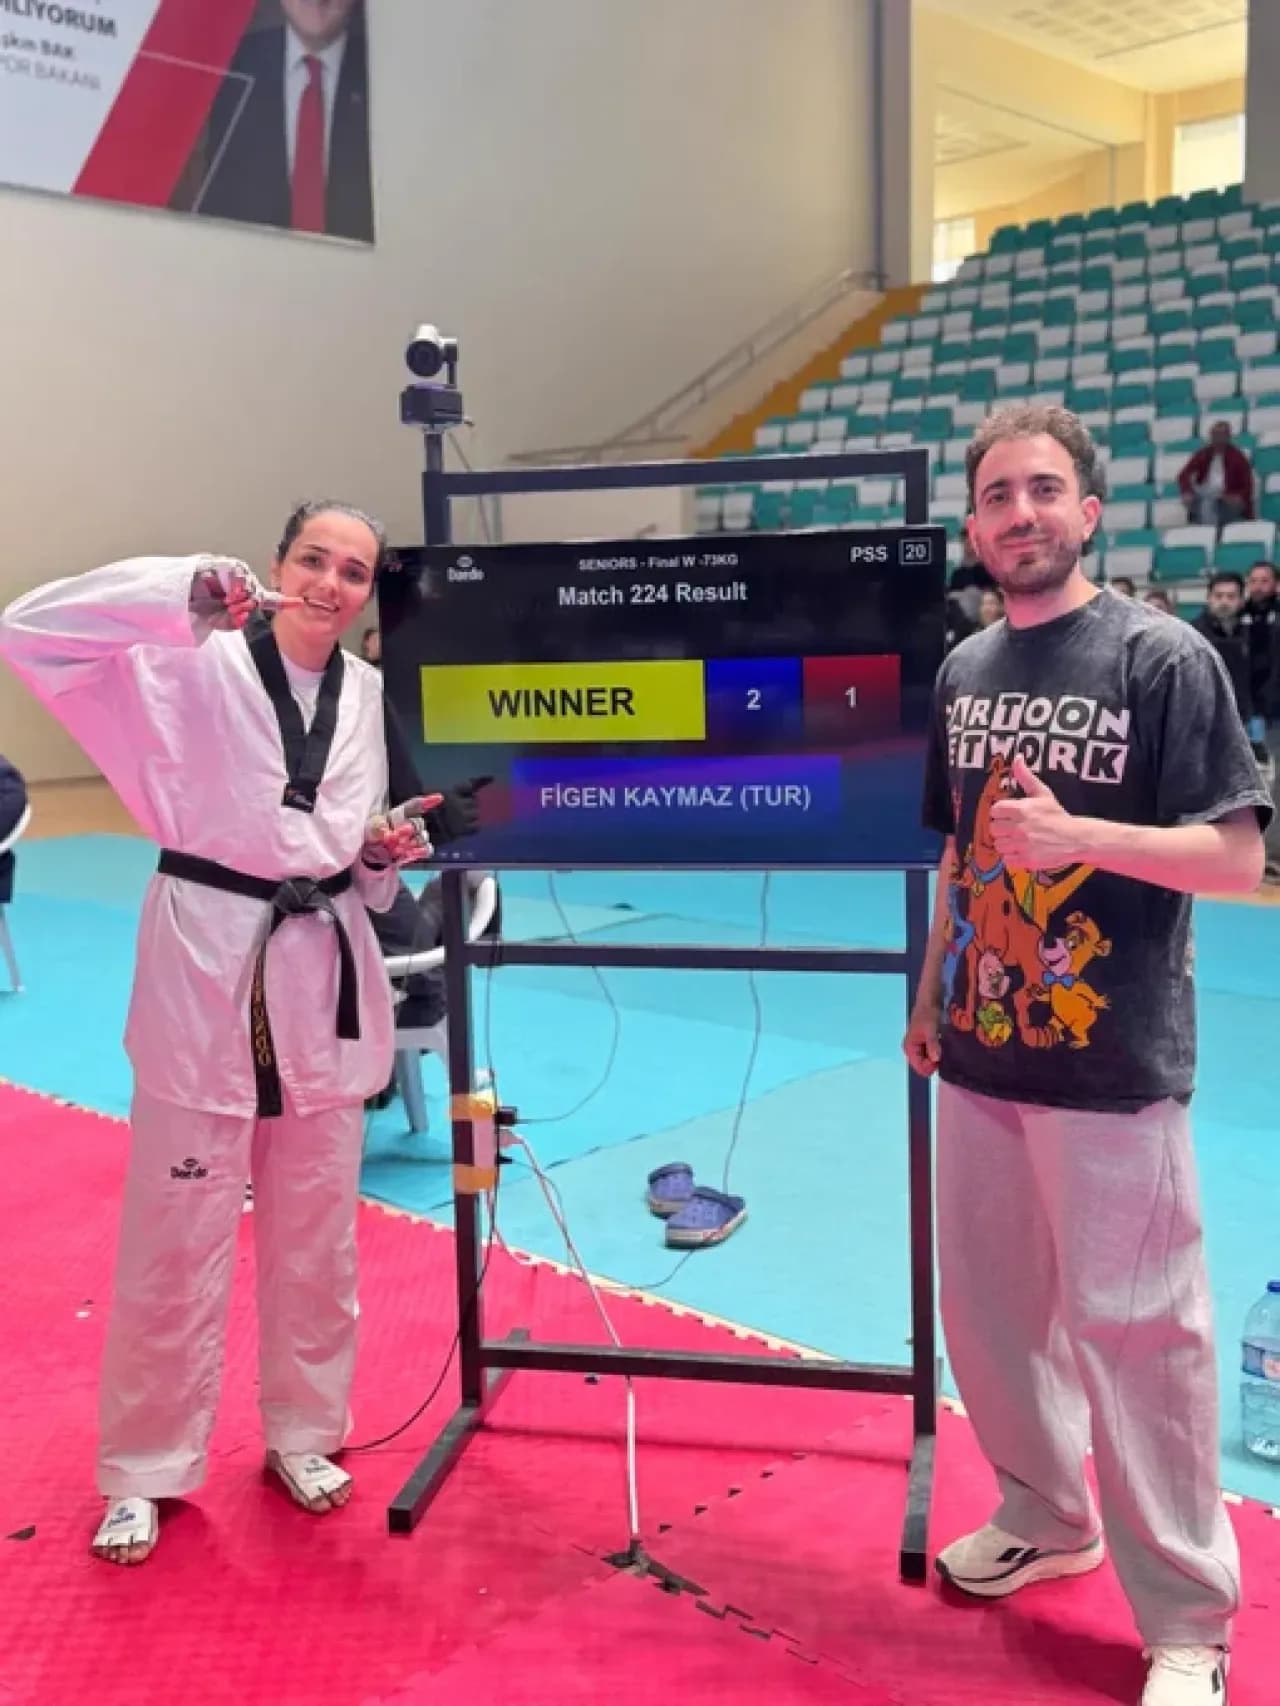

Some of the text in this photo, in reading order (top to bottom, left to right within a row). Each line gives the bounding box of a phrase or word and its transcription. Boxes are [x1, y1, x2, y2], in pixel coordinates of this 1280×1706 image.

[579, 557, 637, 571] SENIORS
[648, 556, 680, 569] Final
[682, 555, 696, 567] W
[850, 543, 927, 563] PSS 20
[558, 580, 748, 606] Match 224 Result
[488, 687, 636, 719] WINNER
[746, 690, 761, 710] 2
[845, 687, 857, 708] 1
[946, 692, 1131, 740] ARTOON
[541, 782, 812, 811] FİGEN KAYMAZ (TUR)
